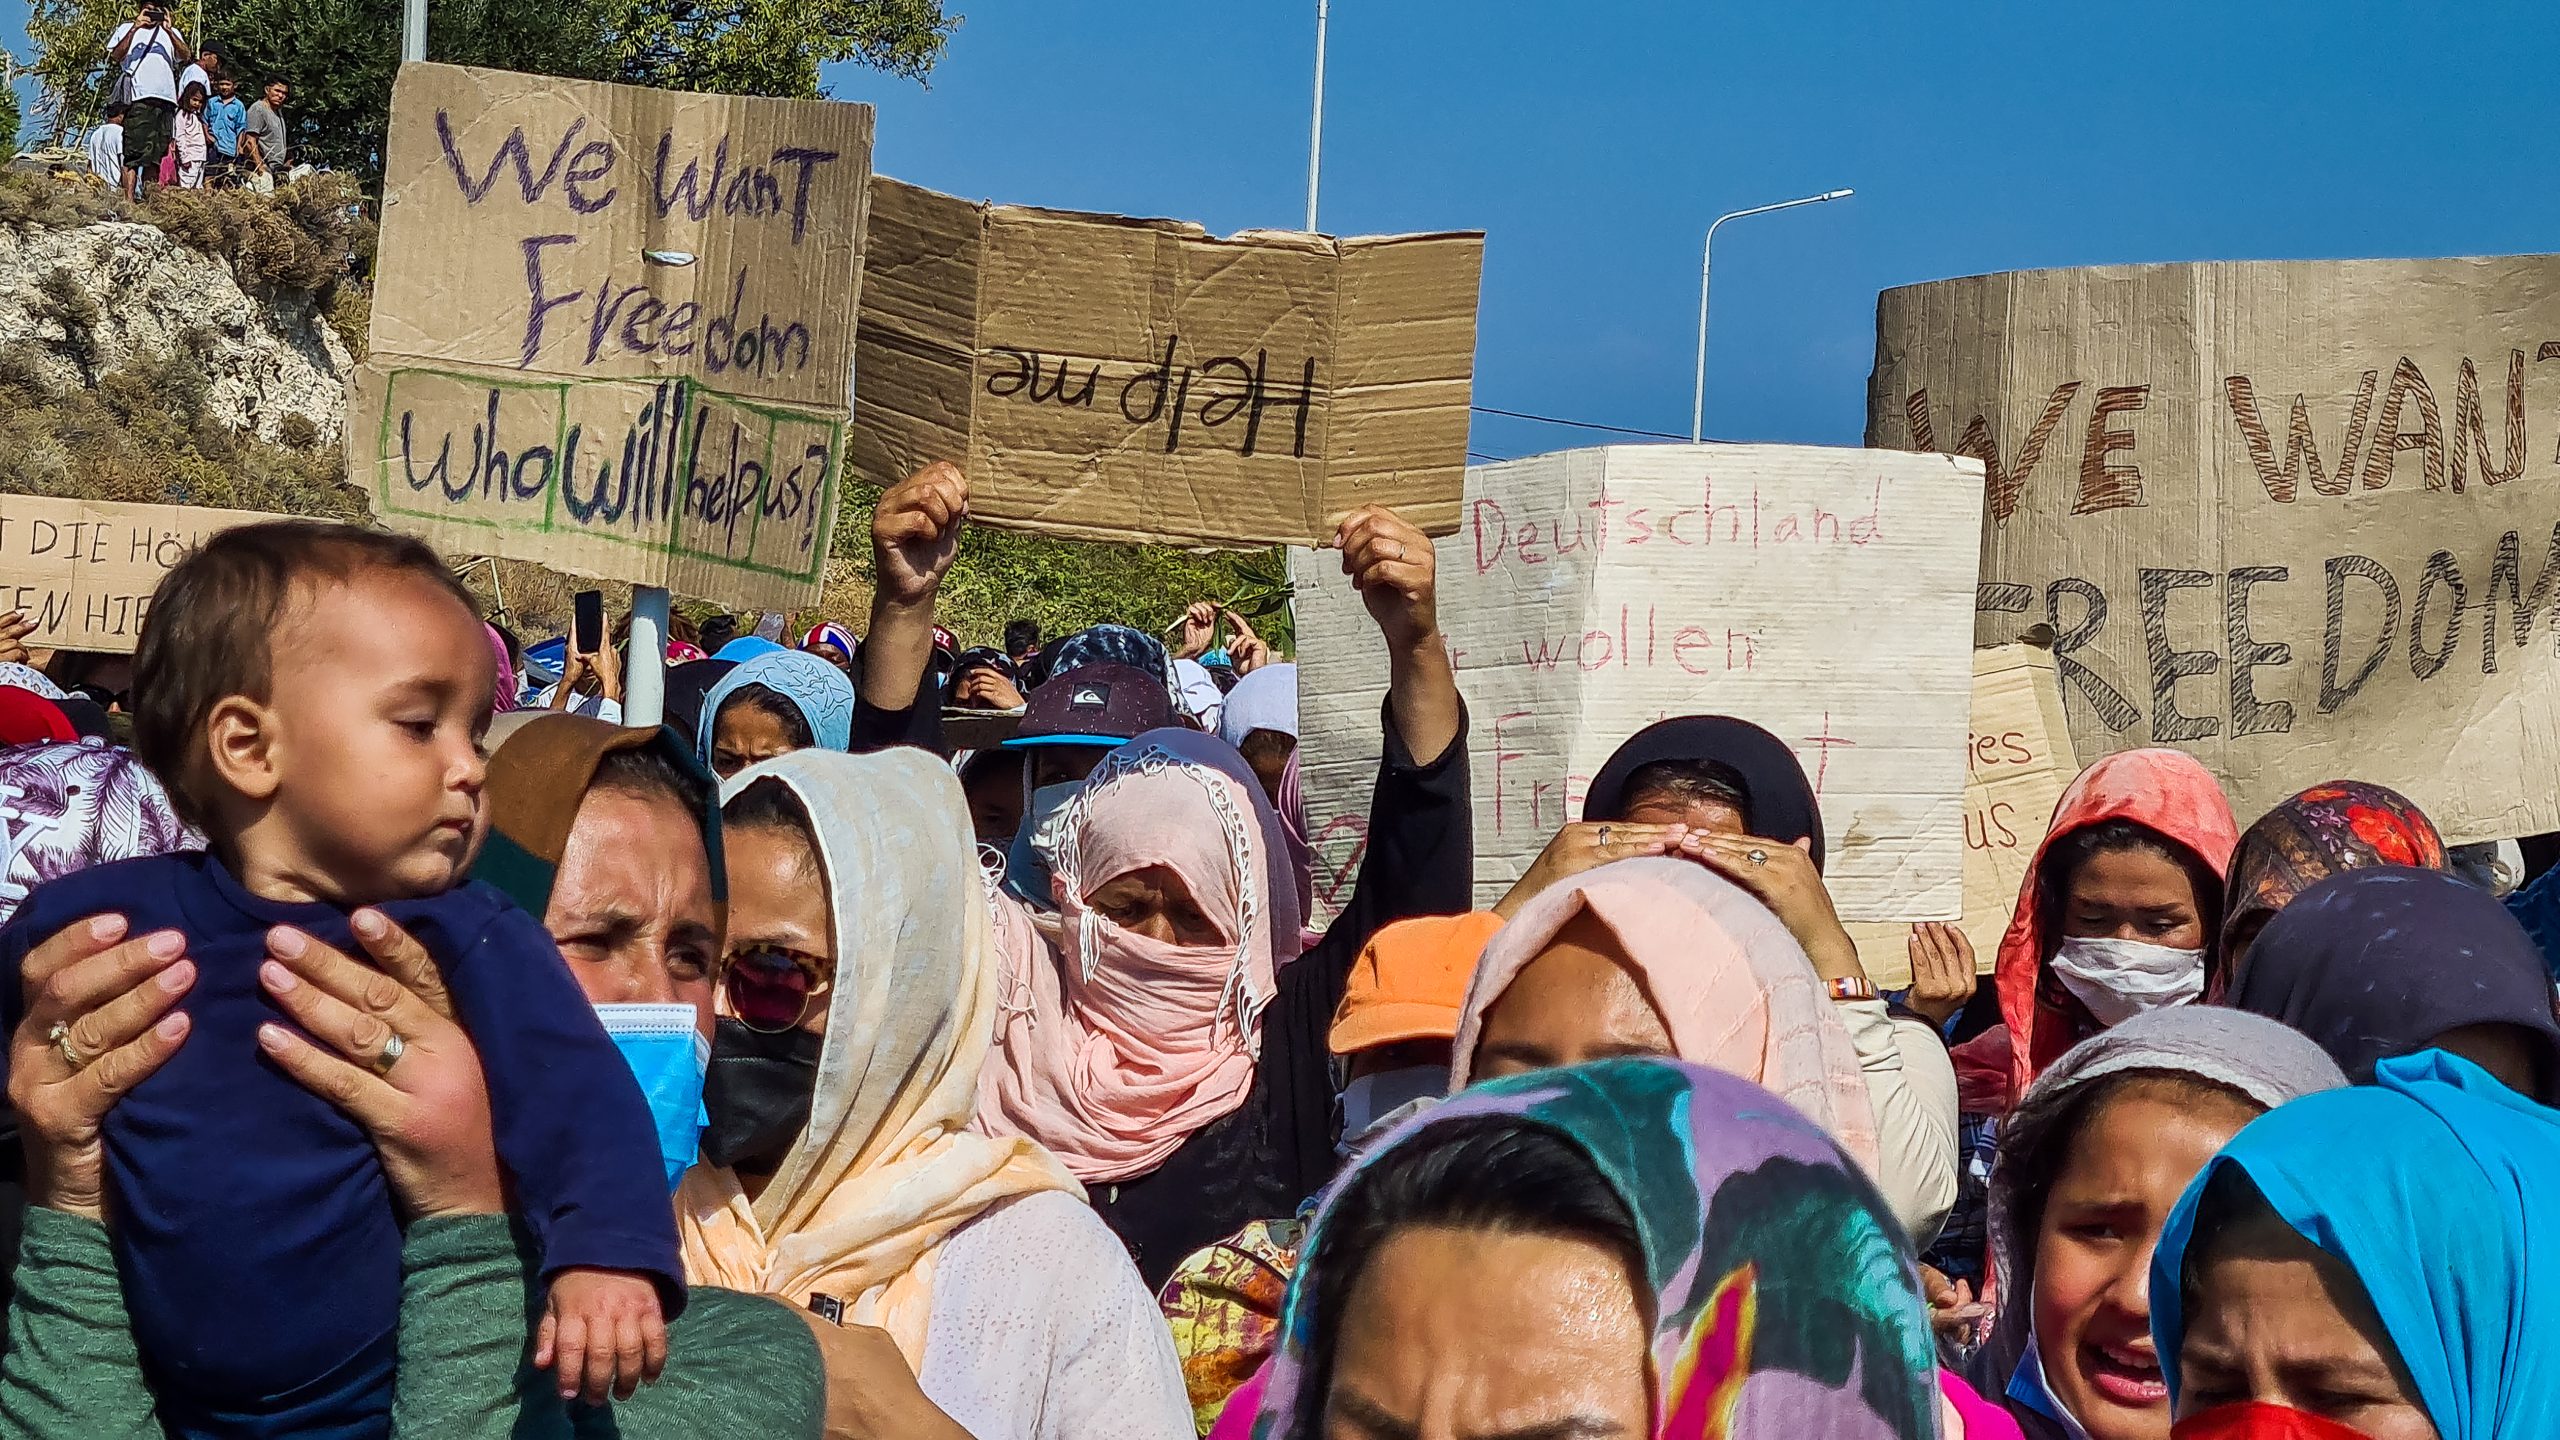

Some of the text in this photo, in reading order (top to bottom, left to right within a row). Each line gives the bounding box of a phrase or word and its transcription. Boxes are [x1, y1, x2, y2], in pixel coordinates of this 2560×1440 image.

[435, 107, 617, 215] We
[520, 234, 811, 380] Freedom
[987, 335, 1315, 458] Help me
[684, 406, 763, 558] help
[763, 444, 828, 552] us?
[1905, 380, 2151, 529] WE
[31, 519, 112, 563] DIE
[130, 526, 213, 568] HÖ
[1474, 475, 1884, 575] Deutschland
[1524, 602, 1755, 675] wollen
